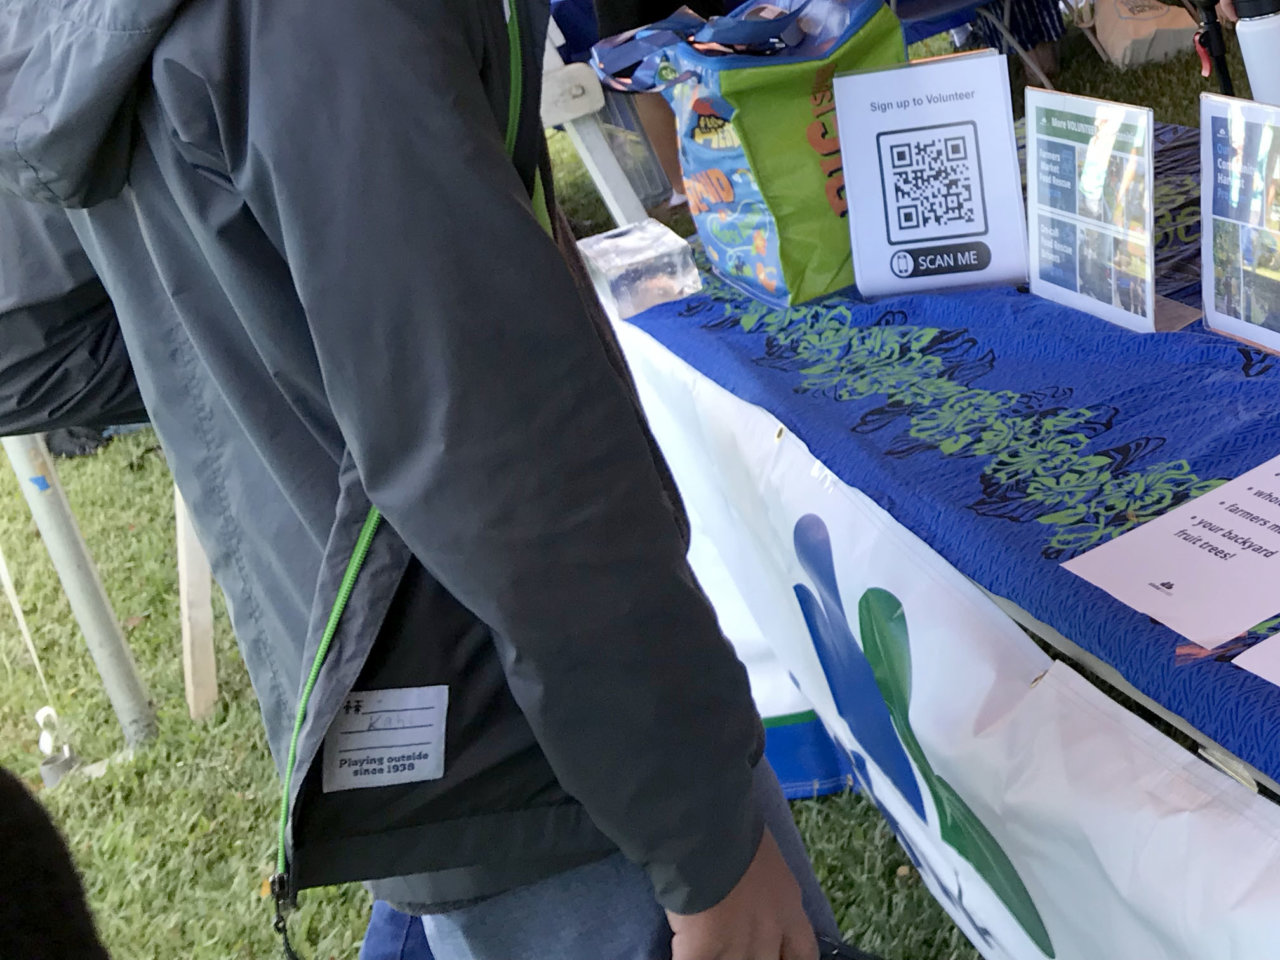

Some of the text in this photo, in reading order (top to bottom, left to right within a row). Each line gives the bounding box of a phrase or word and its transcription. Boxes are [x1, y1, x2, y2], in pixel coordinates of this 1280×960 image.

[870, 90, 976, 114] Sign up to Volunteer
[918, 250, 979, 270] SCAN ME
[1224, 502, 1270, 526] farmers
[1174, 528, 1236, 560] fruit trees!
[1191, 515, 1278, 558] your backyard
[339, 751, 430, 769] Playing outside
[352, 762, 416, 777] since 1938
